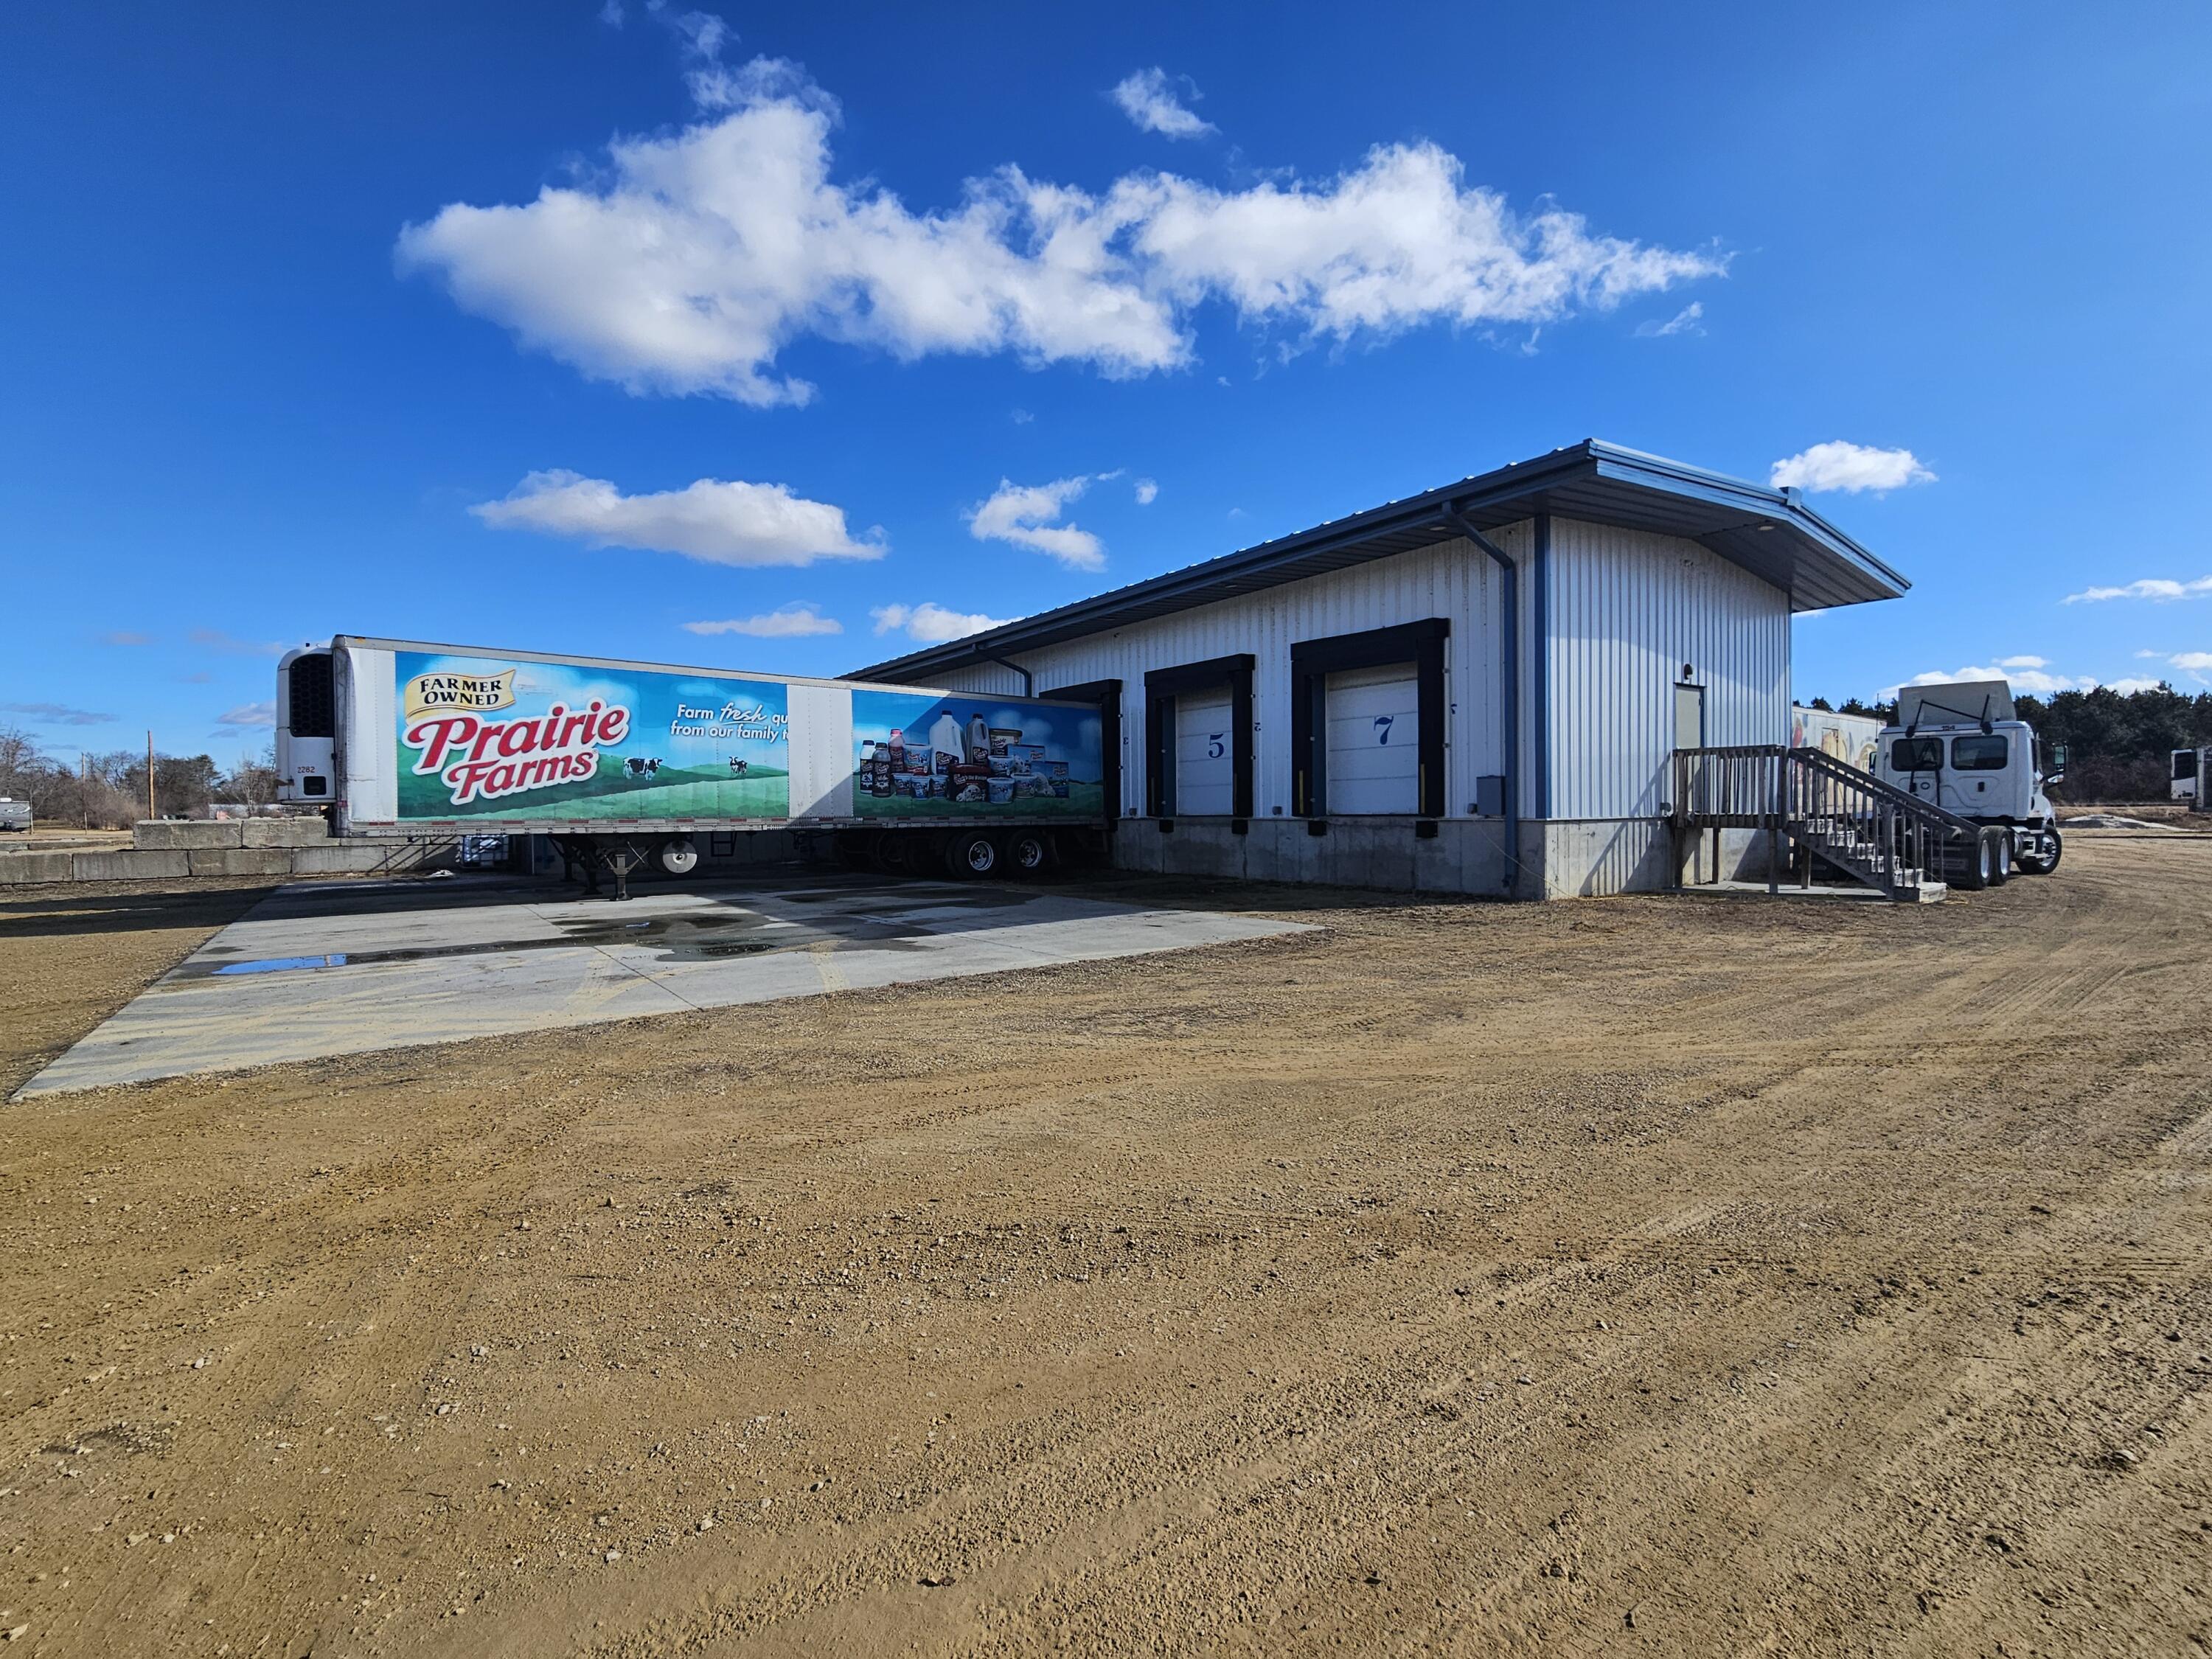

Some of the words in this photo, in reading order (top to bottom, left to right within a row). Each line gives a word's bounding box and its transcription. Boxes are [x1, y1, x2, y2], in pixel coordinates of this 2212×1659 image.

[420, 678, 502, 693] FARMER
[424, 691, 499, 705] OWNED
[677, 703, 714, 720] Farm
[719, 703, 767, 722] fresh
[408, 701, 625, 769] Prairie
[670, 720, 705, 737] from
[709, 726, 733, 737] our
[737, 723, 779, 743] family
[1374, 715, 1394, 745] 7
[1208, 733, 1225, 759] 5
[448, 752, 594, 799] Farms
